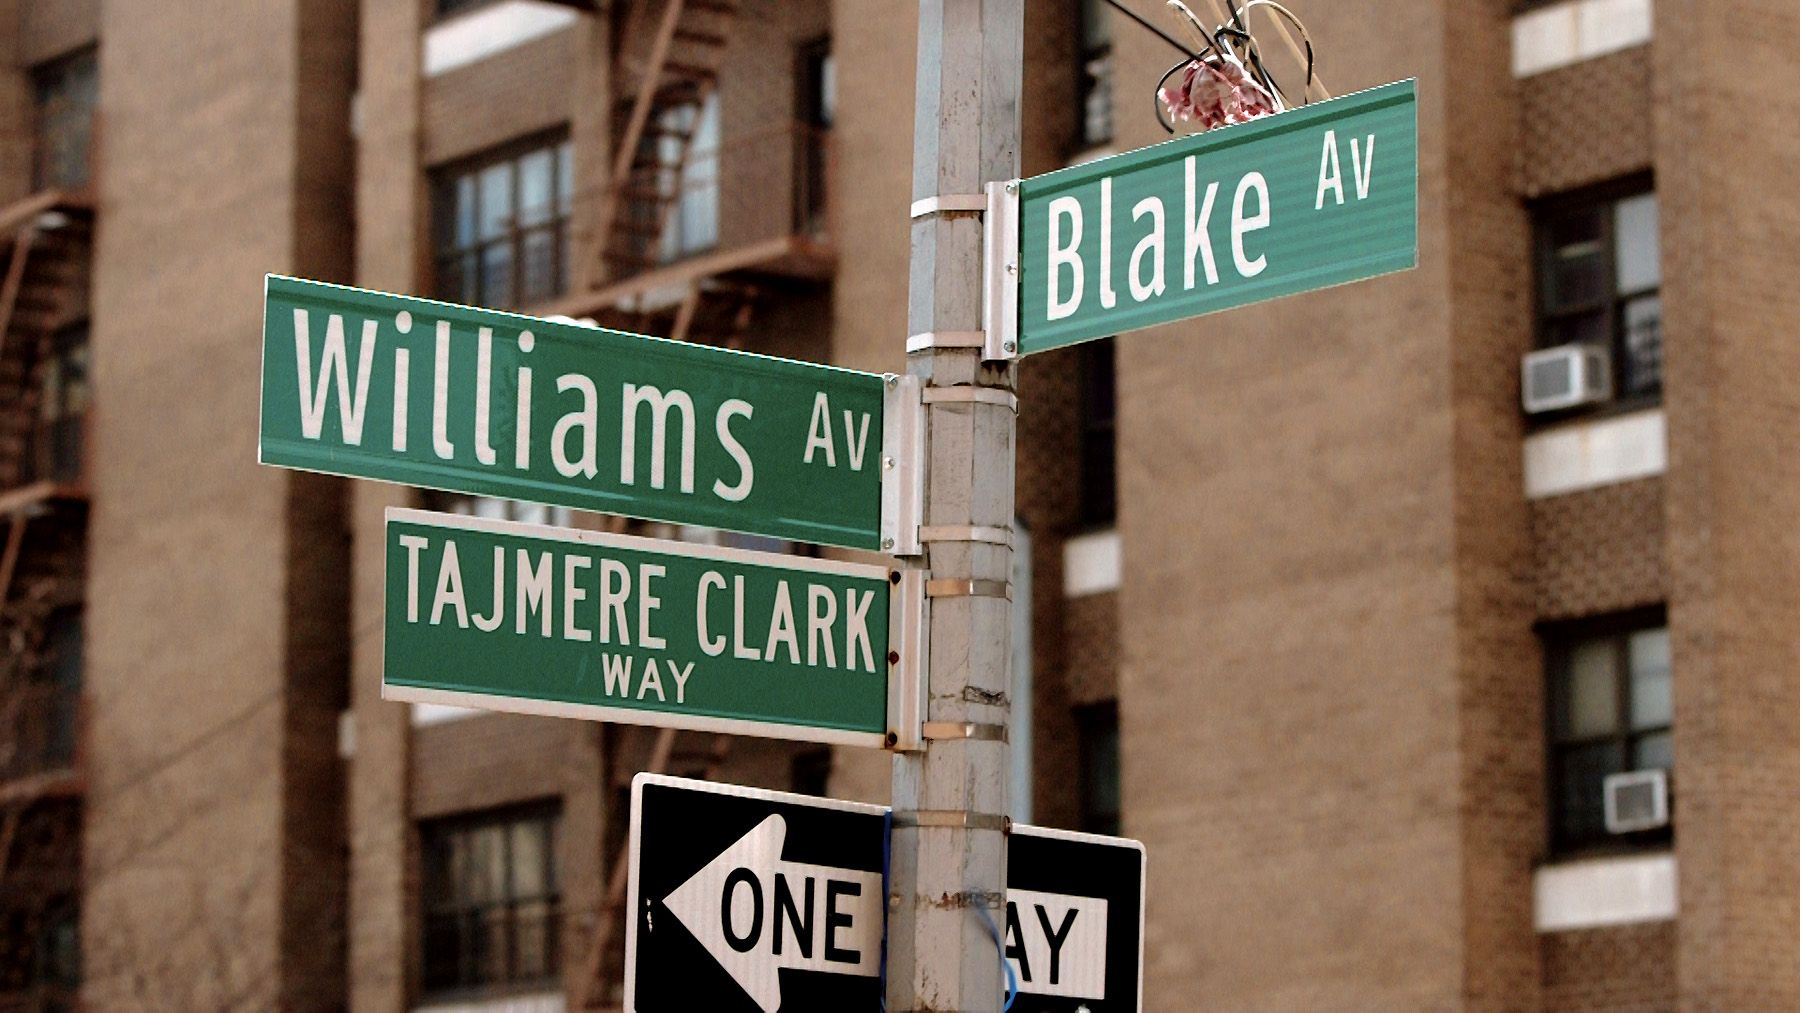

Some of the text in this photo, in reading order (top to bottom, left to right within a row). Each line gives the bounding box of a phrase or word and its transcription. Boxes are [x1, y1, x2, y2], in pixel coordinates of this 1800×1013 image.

[1047, 129, 1376, 321] Blake Av
[293, 308, 871, 501] Williams Av
[399, 534, 877, 673] TAJMERE CLARK
[602, 653, 695, 704] WAY
[721, 867, 1080, 985] ONE AY
